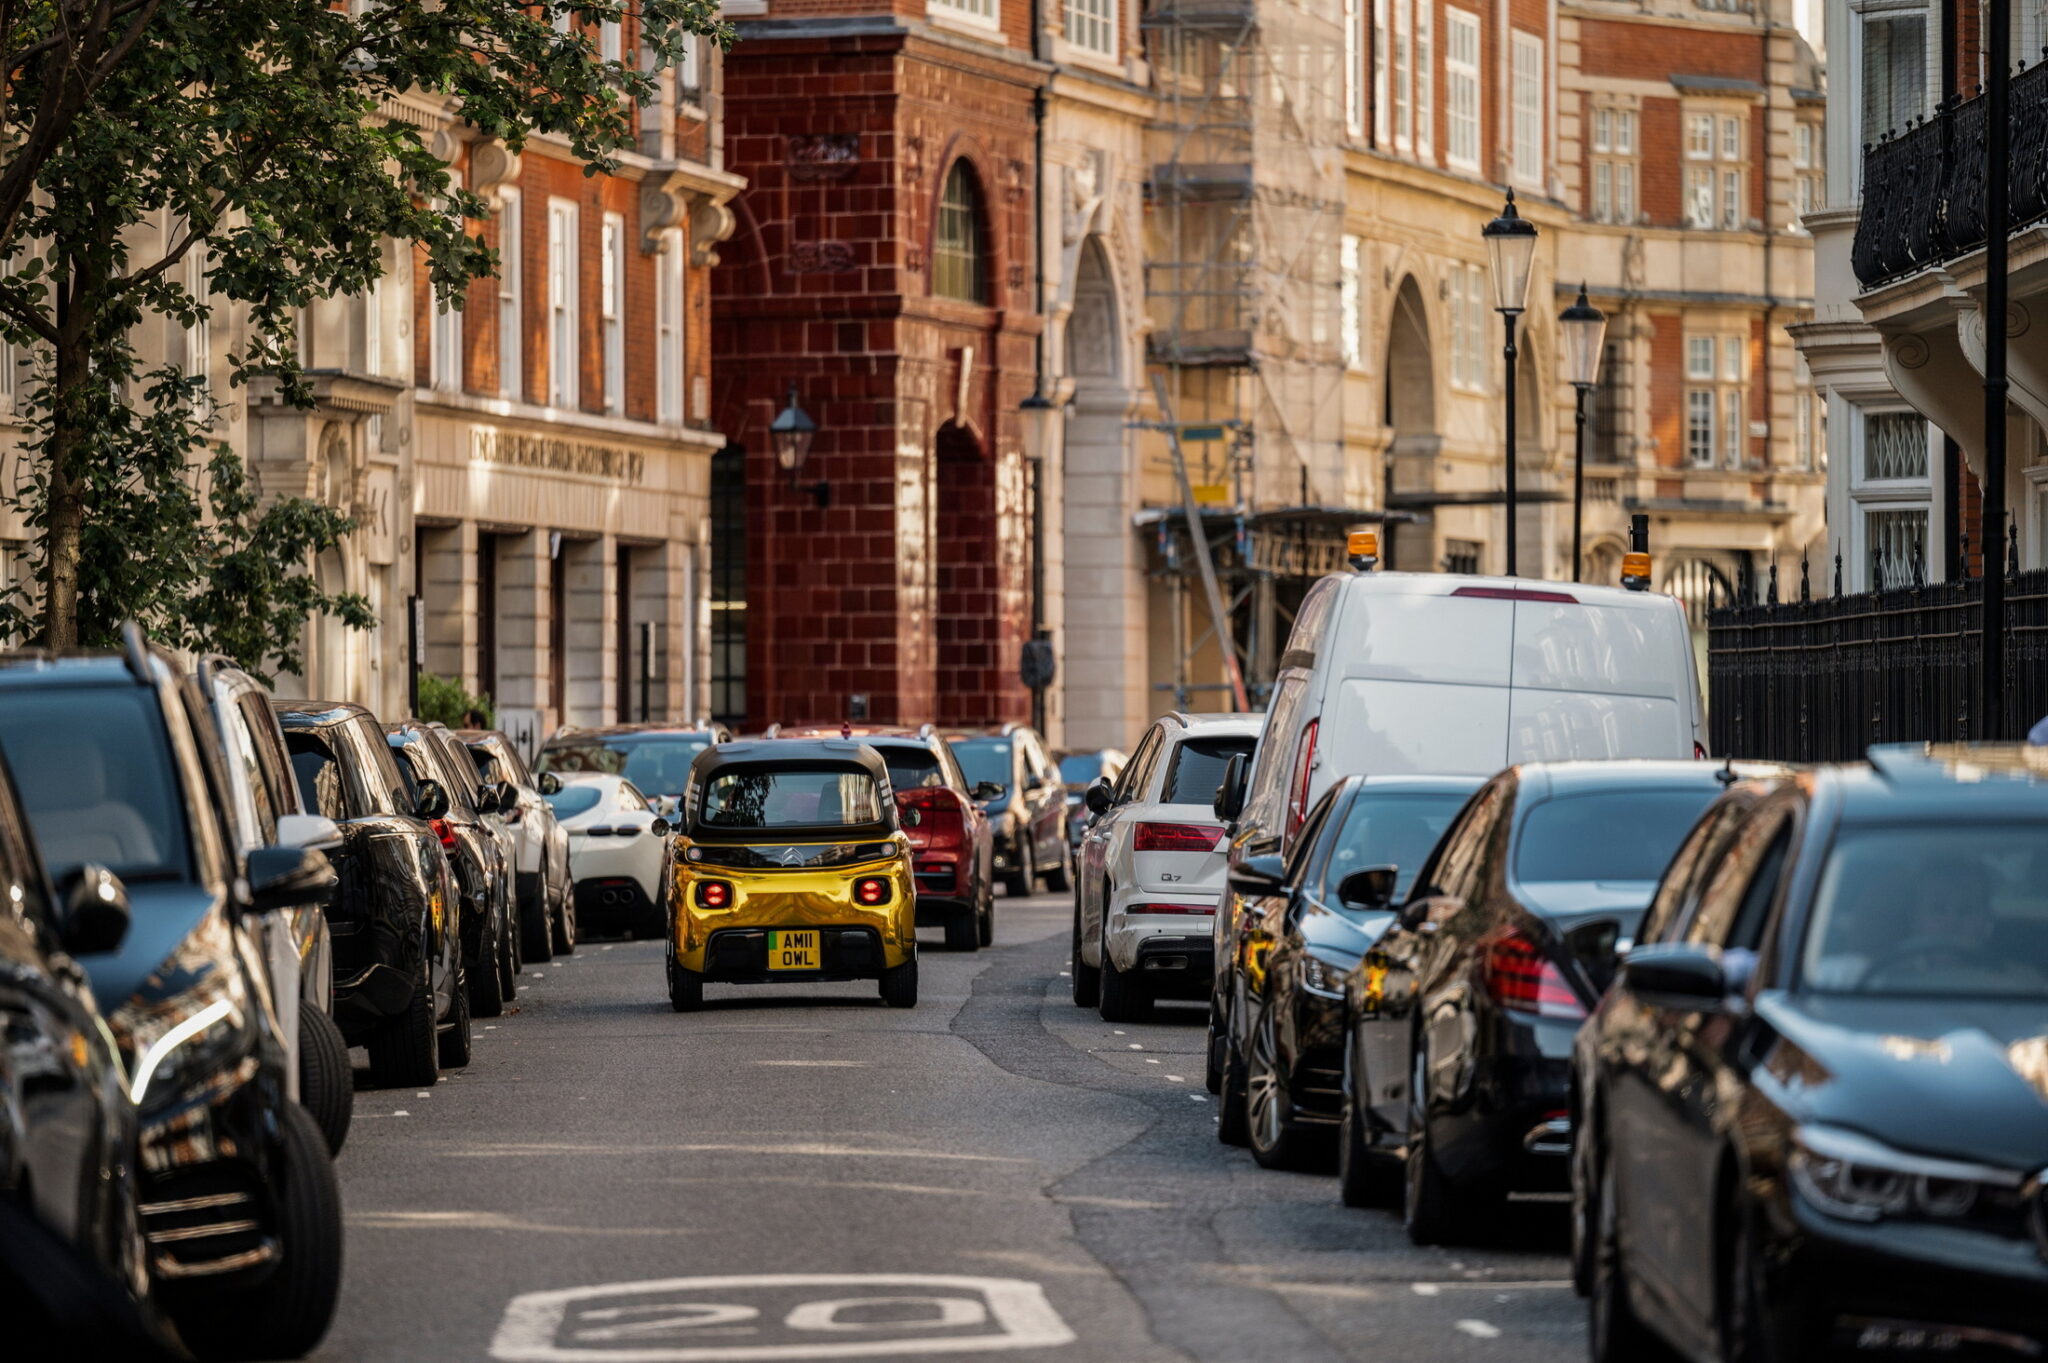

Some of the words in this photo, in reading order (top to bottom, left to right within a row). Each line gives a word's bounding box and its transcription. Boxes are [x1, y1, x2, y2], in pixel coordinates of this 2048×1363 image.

[1161, 873, 1182, 882] Q7
[782, 951, 814, 966] OWL
[573, 1297, 987, 1340] 20
